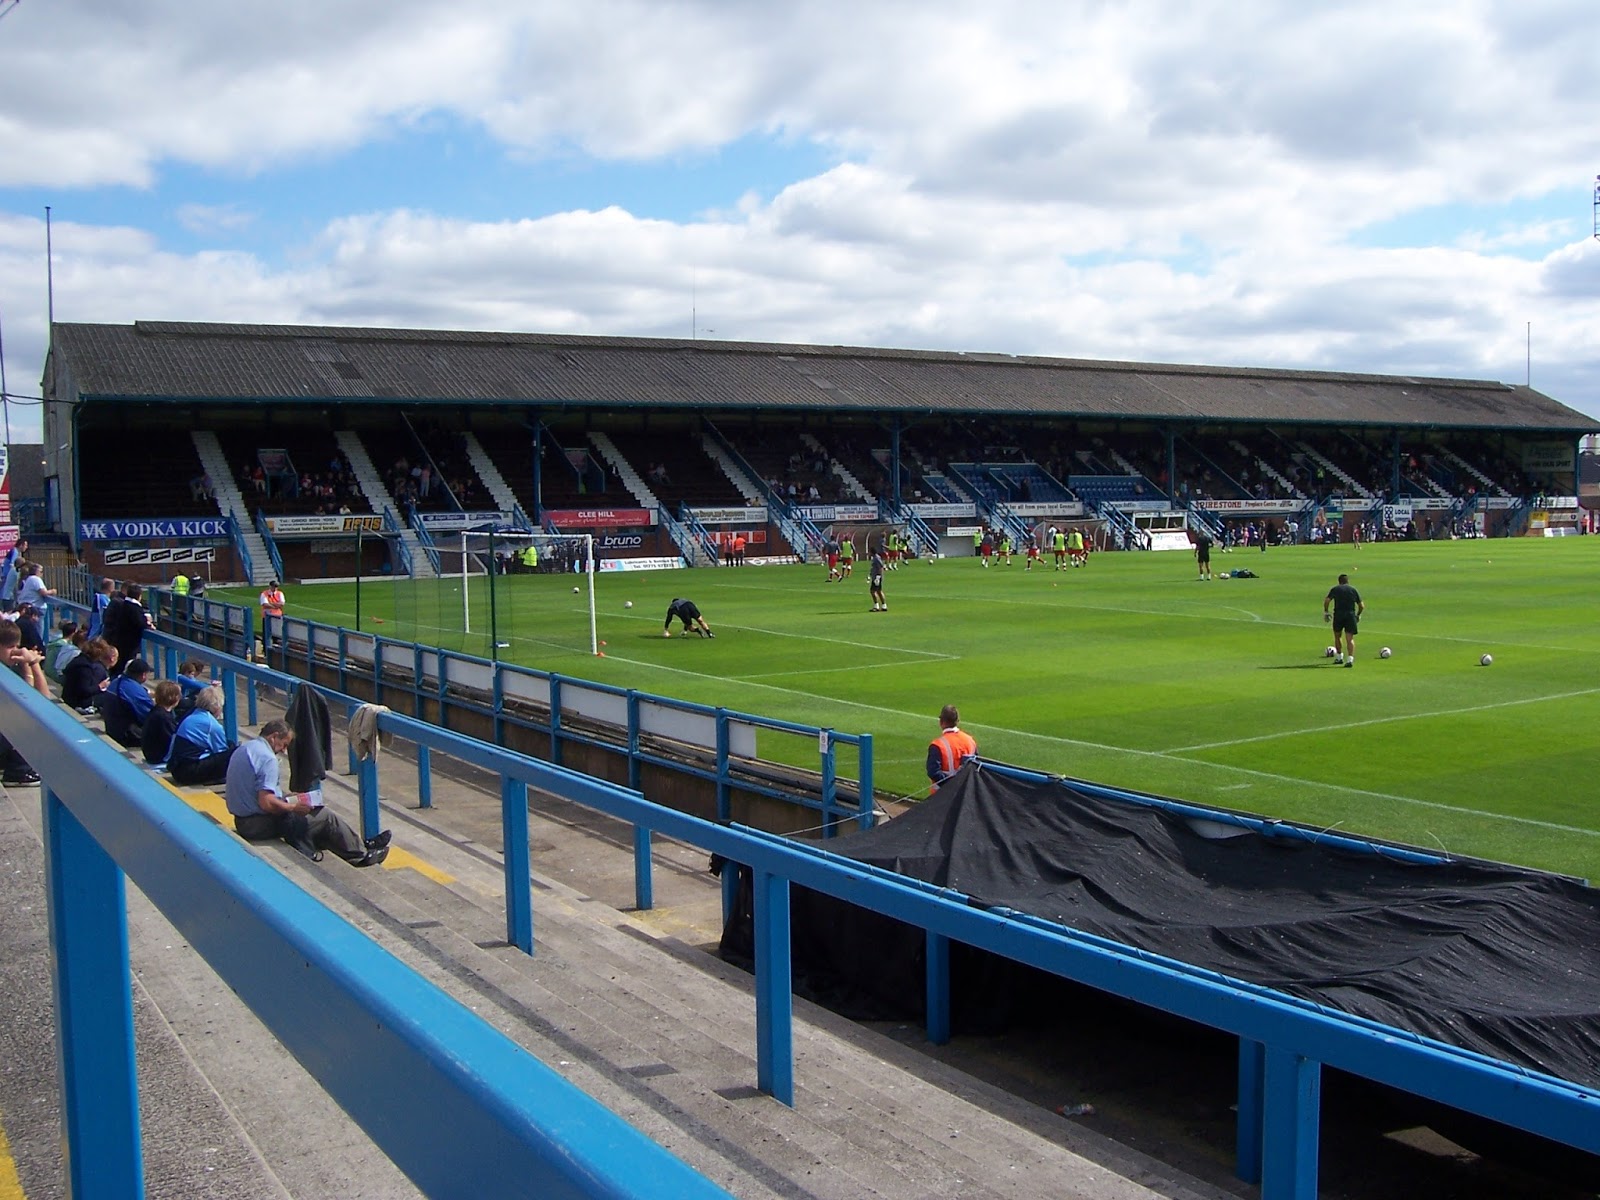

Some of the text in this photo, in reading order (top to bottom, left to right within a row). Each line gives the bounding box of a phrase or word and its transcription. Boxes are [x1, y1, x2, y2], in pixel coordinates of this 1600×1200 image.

[81, 520, 227, 539] VK VODKA KICK
[343, 517, 382, 531] ISIS
[604, 536, 642, 545] bruno
